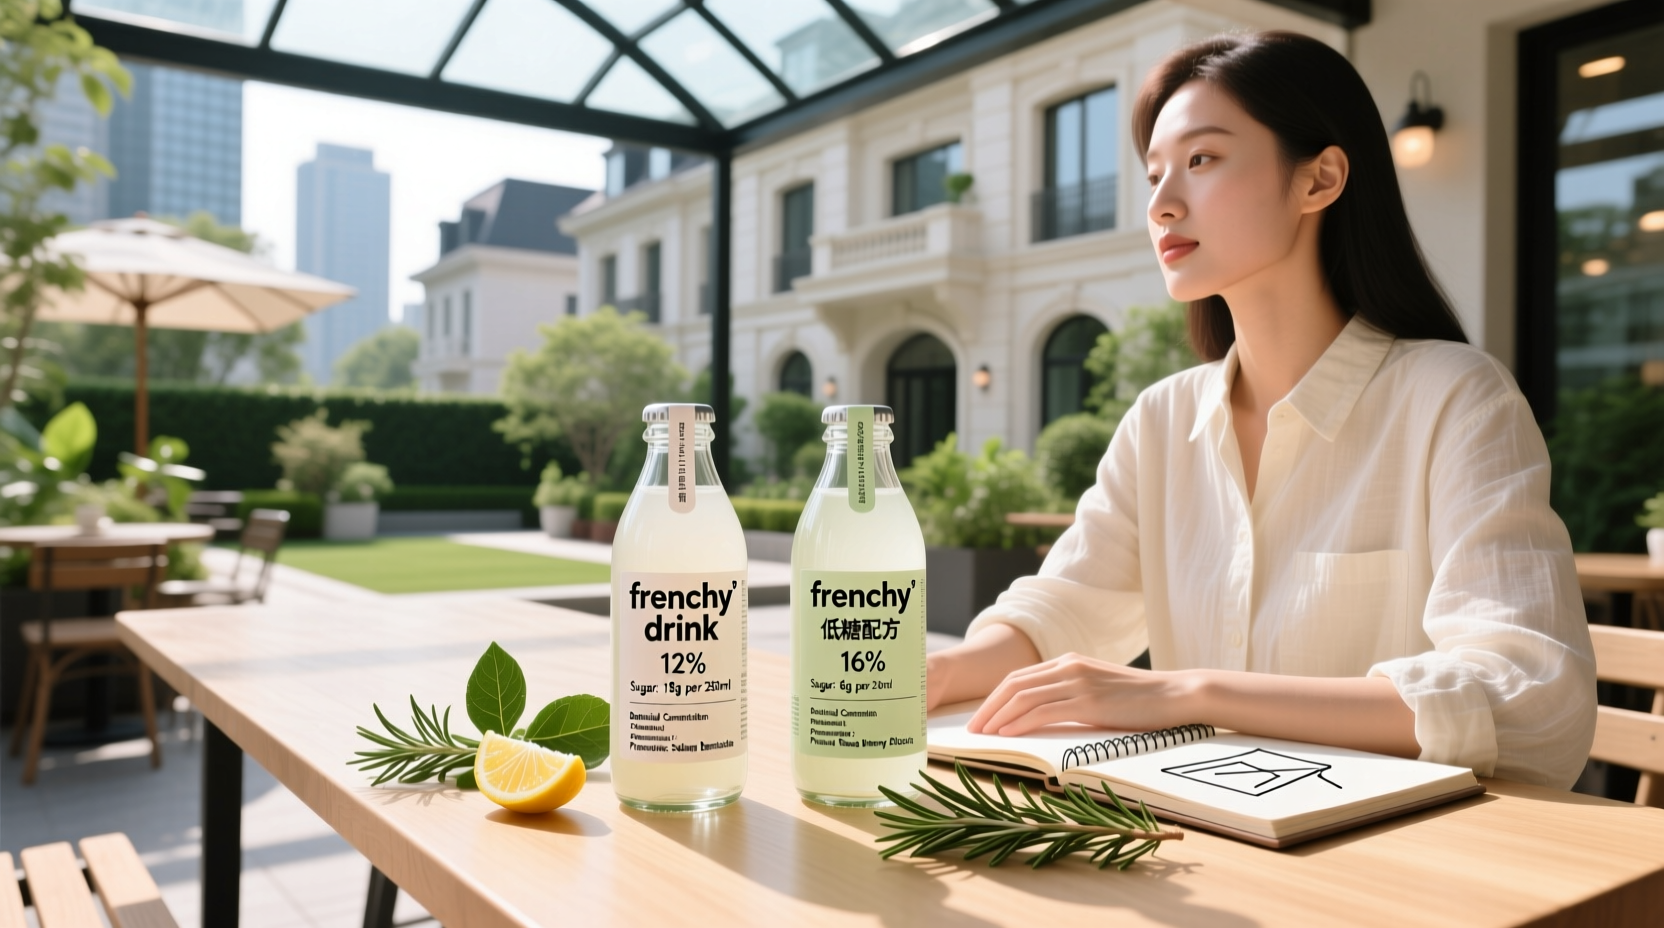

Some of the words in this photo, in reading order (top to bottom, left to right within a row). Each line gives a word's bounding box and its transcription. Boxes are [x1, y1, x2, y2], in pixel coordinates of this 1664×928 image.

[644, 614, 719, 642] drink
[820, 617, 901, 641] 低糖配方
[660, 652, 706, 675] 12%
[840, 650, 886, 673] 16%
[685, 684, 702, 697] per
[839, 679, 852, 694] 6g
